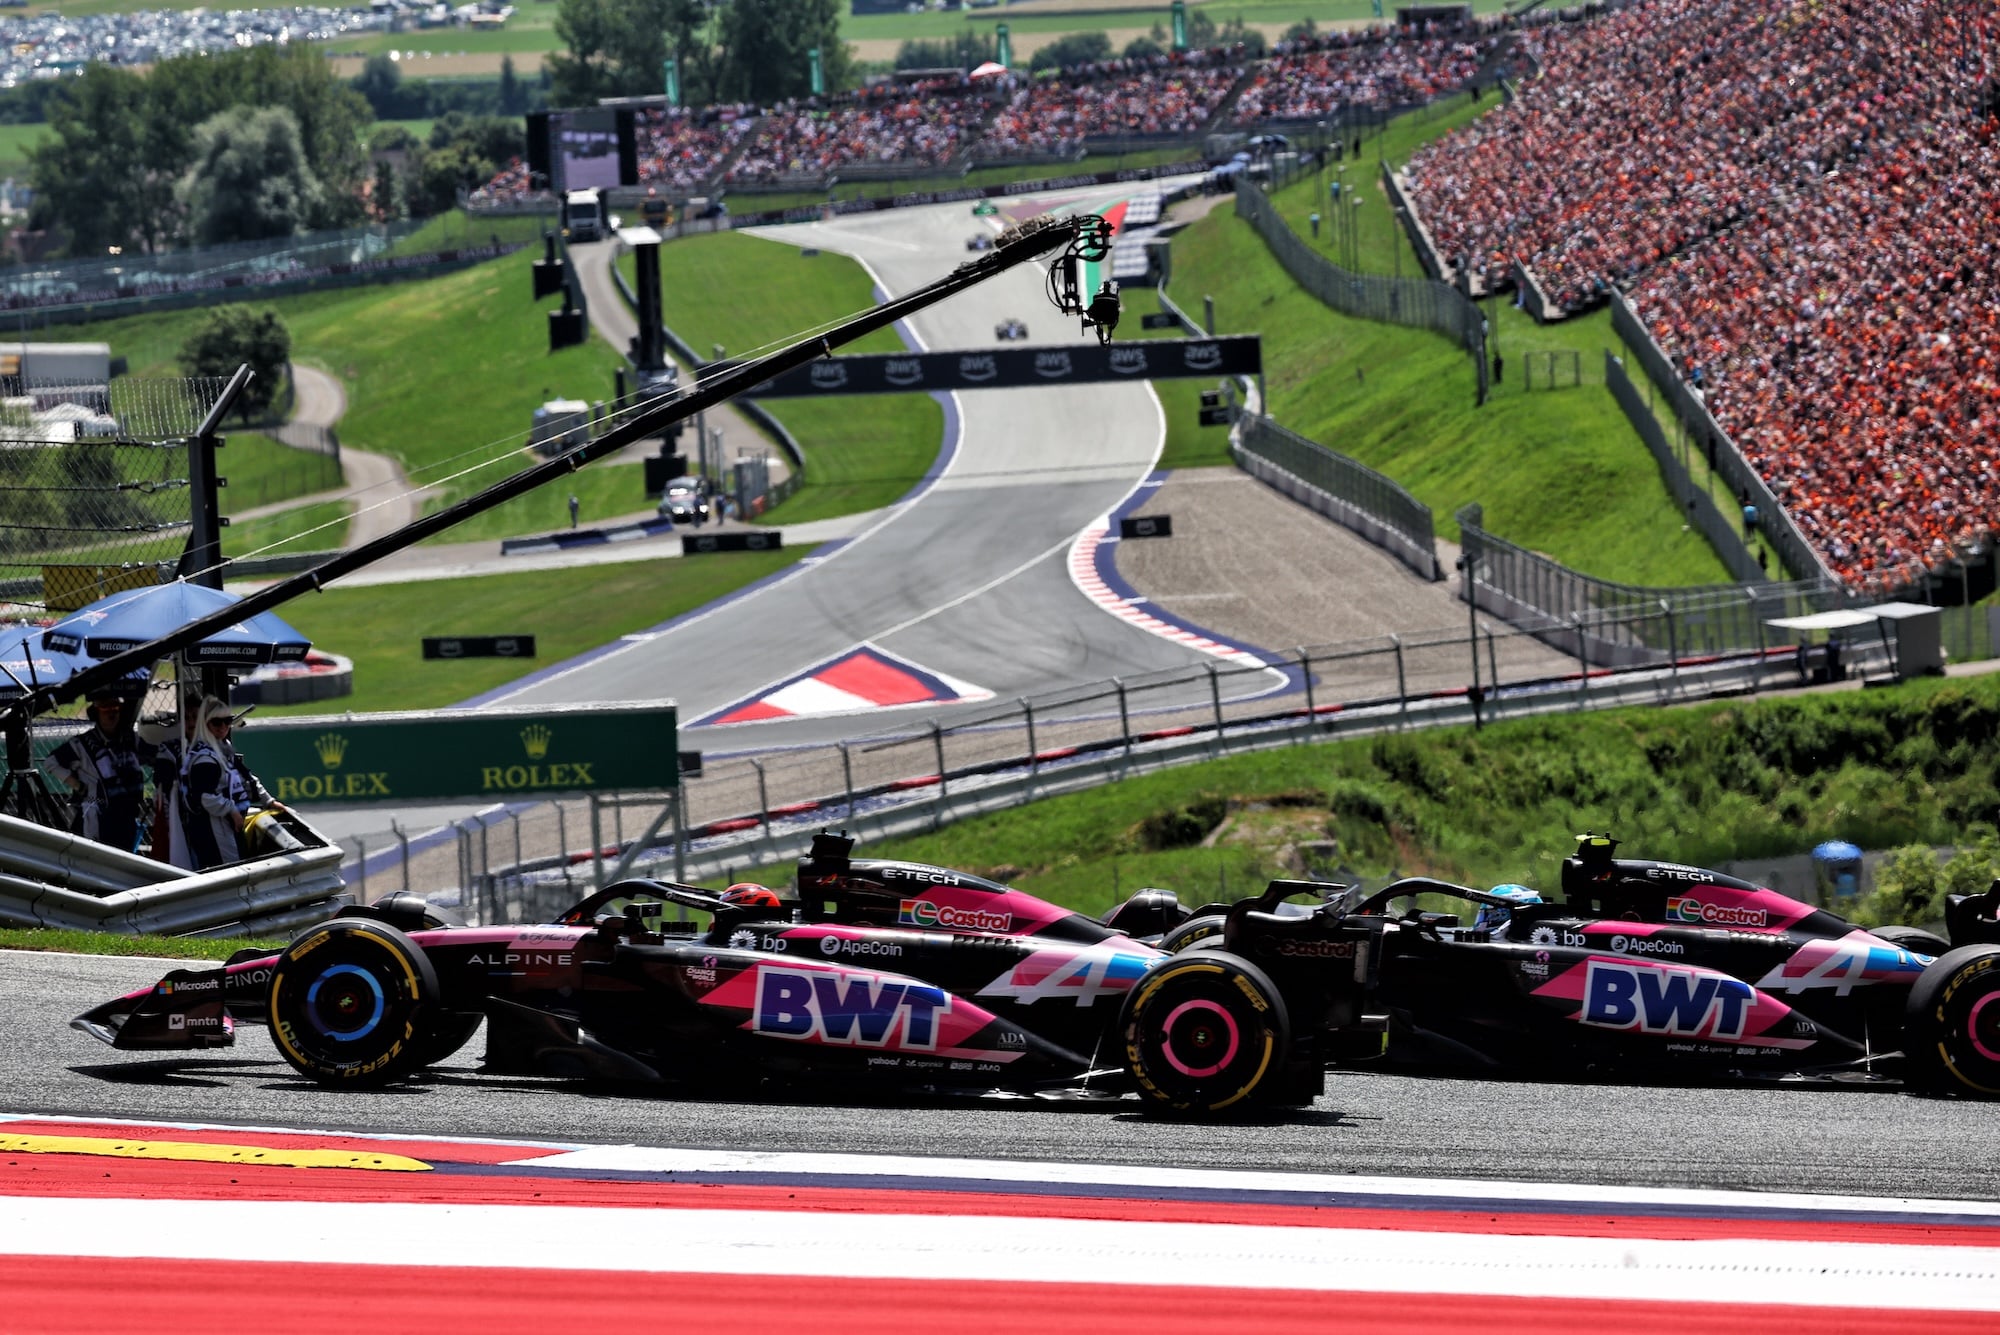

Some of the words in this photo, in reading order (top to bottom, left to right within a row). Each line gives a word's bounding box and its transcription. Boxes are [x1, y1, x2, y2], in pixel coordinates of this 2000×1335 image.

[812, 362, 845, 378] aws
[886, 359, 920, 375] aws
[960, 355, 995, 371] aws
[1035, 351, 1070, 368] aws
[1110, 347, 1145, 364] aws
[1184, 344, 1220, 360] aws
[276, 772, 391, 799] ROLEX
[482, 763, 596, 790] ROLEX
[1646, 868, 1714, 882] E-TECH
[1656, 863, 1700, 872] RENAULT
[881, 868, 961, 886] E-TECH
[938, 906, 1012, 931] Castrol
[1701, 903, 1767, 926] Castrol
[762, 935, 788, 953] bp
[841, 935, 903, 957] ApeCoin
[1563, 930, 1587, 947] bp
[1629, 937, 1684, 955] ApeCoin
[1279, 938, 1355, 959] Castrol
[466, 953, 573, 966] ALPINE
[174, 979, 219, 991] Microsoft
[1941, 957, 1993, 1003] ZERO
[755, 967, 950, 1049] BWT
[1581, 962, 1756, 1038] BWT
[186, 1016, 218, 1026] mntn
[999, 1032, 1026, 1044] ADA
[1667, 1043, 1696, 1052] yahoo!
[343, 1039, 403, 1078] ZERO
[868, 1056, 901, 1066] yahoo!
